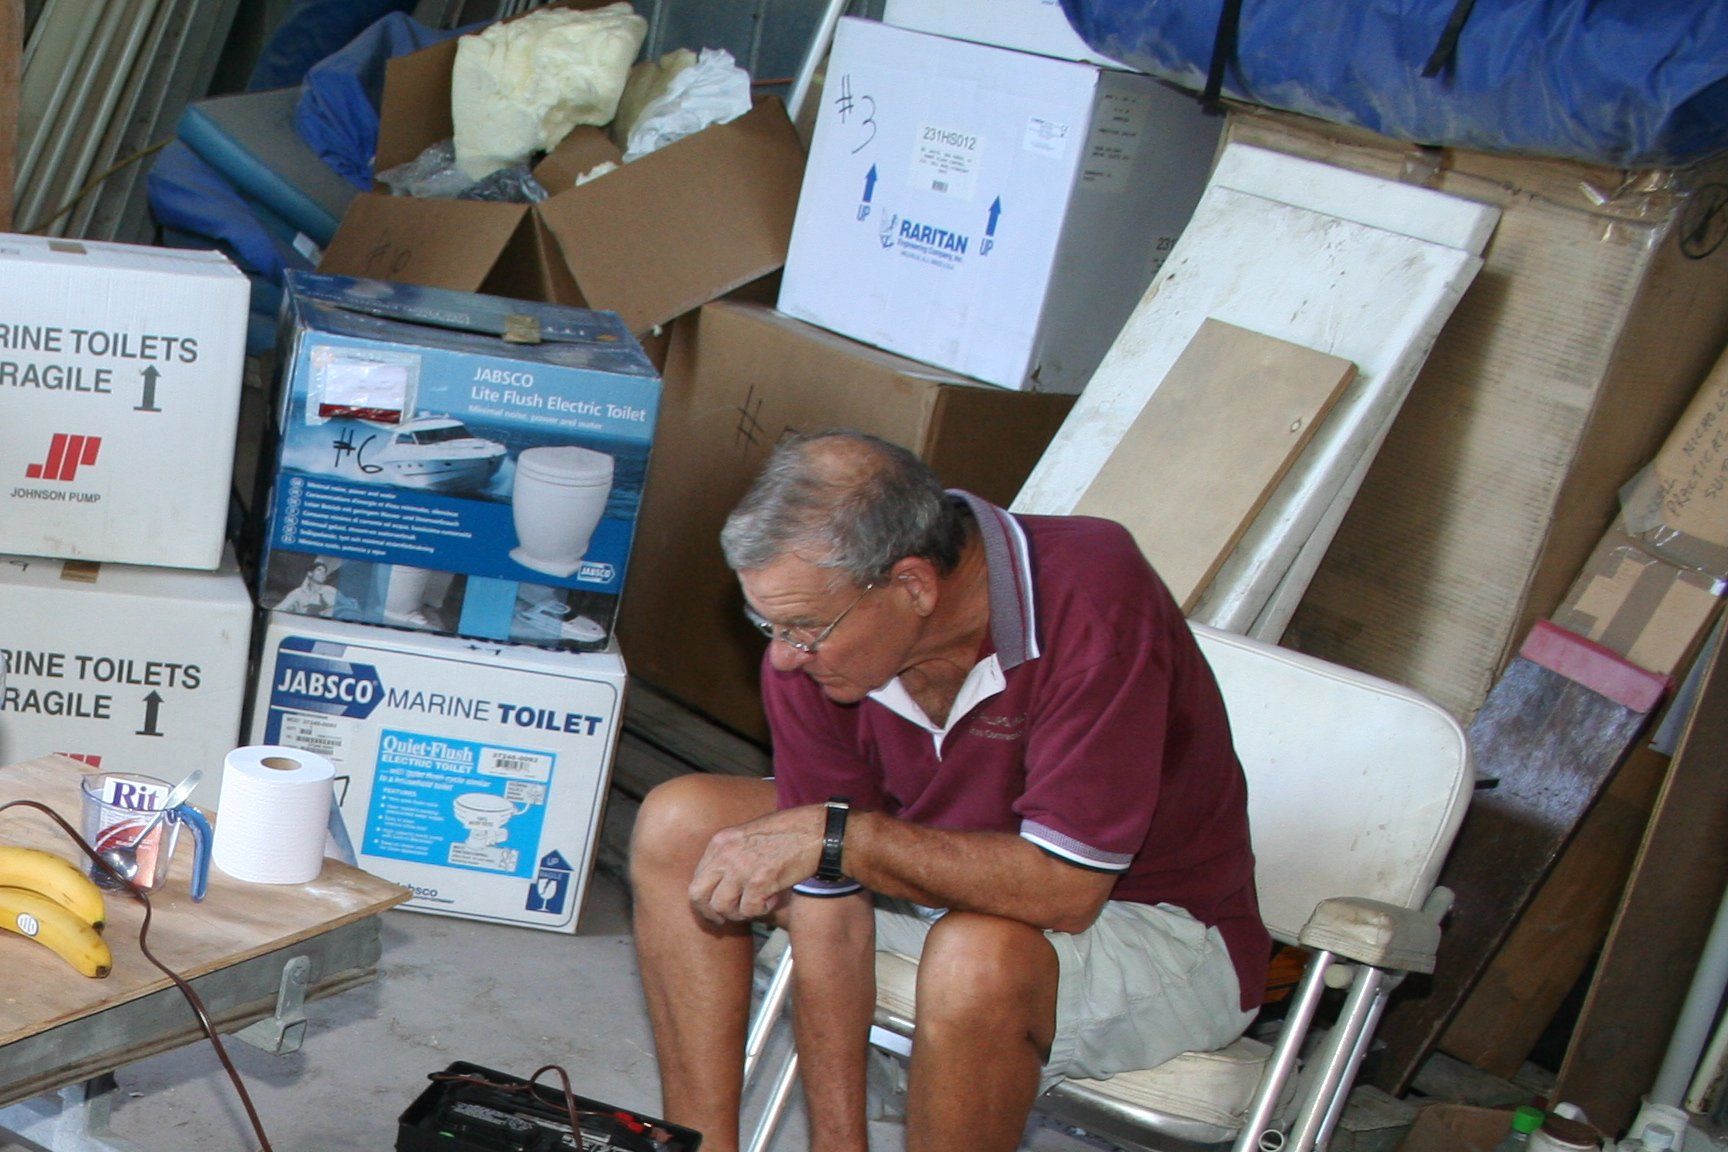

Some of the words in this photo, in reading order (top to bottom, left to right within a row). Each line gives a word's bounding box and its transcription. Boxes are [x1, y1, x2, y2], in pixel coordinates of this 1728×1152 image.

[835, 73, 877, 154] #3
[922, 126, 977, 151] 231HS012
[856, 203, 872, 222] UP
[899, 219, 969, 254] RARITAN
[979, 238, 994, 257] UP
[71, 328, 198, 363] TOILETS
[473, 367, 534, 388] JABSCO
[471, 386, 500, 402] Lite
[503, 390, 543, 408] Flush
[547, 396, 602, 416] Electric
[606, 404, 647, 422] Toilet
[333, 427, 383, 473] #6
[10, 487, 66, 501] JOHNSON
[69, 491, 101, 503] PUMP
[581, 565, 611, 579] JABSCO
[0, 649, 65, 678] RINE
[75, 655, 201, 689] TOILETS
[2, 687, 112, 719] RAGILE
[277, 667, 375, 704] JABSCO
[387, 687, 490, 722] MARINE
[498, 703, 603, 736] TOILET
[383, 735, 473, 763] Quiet-Flush
[381, 754, 433, 768] ELECTRIC
[436, 761, 472, 774] TOILET
[112, 782, 159, 811] Rit
[546, 857, 559, 866] UP
[406, 883, 438, 897] bsco
